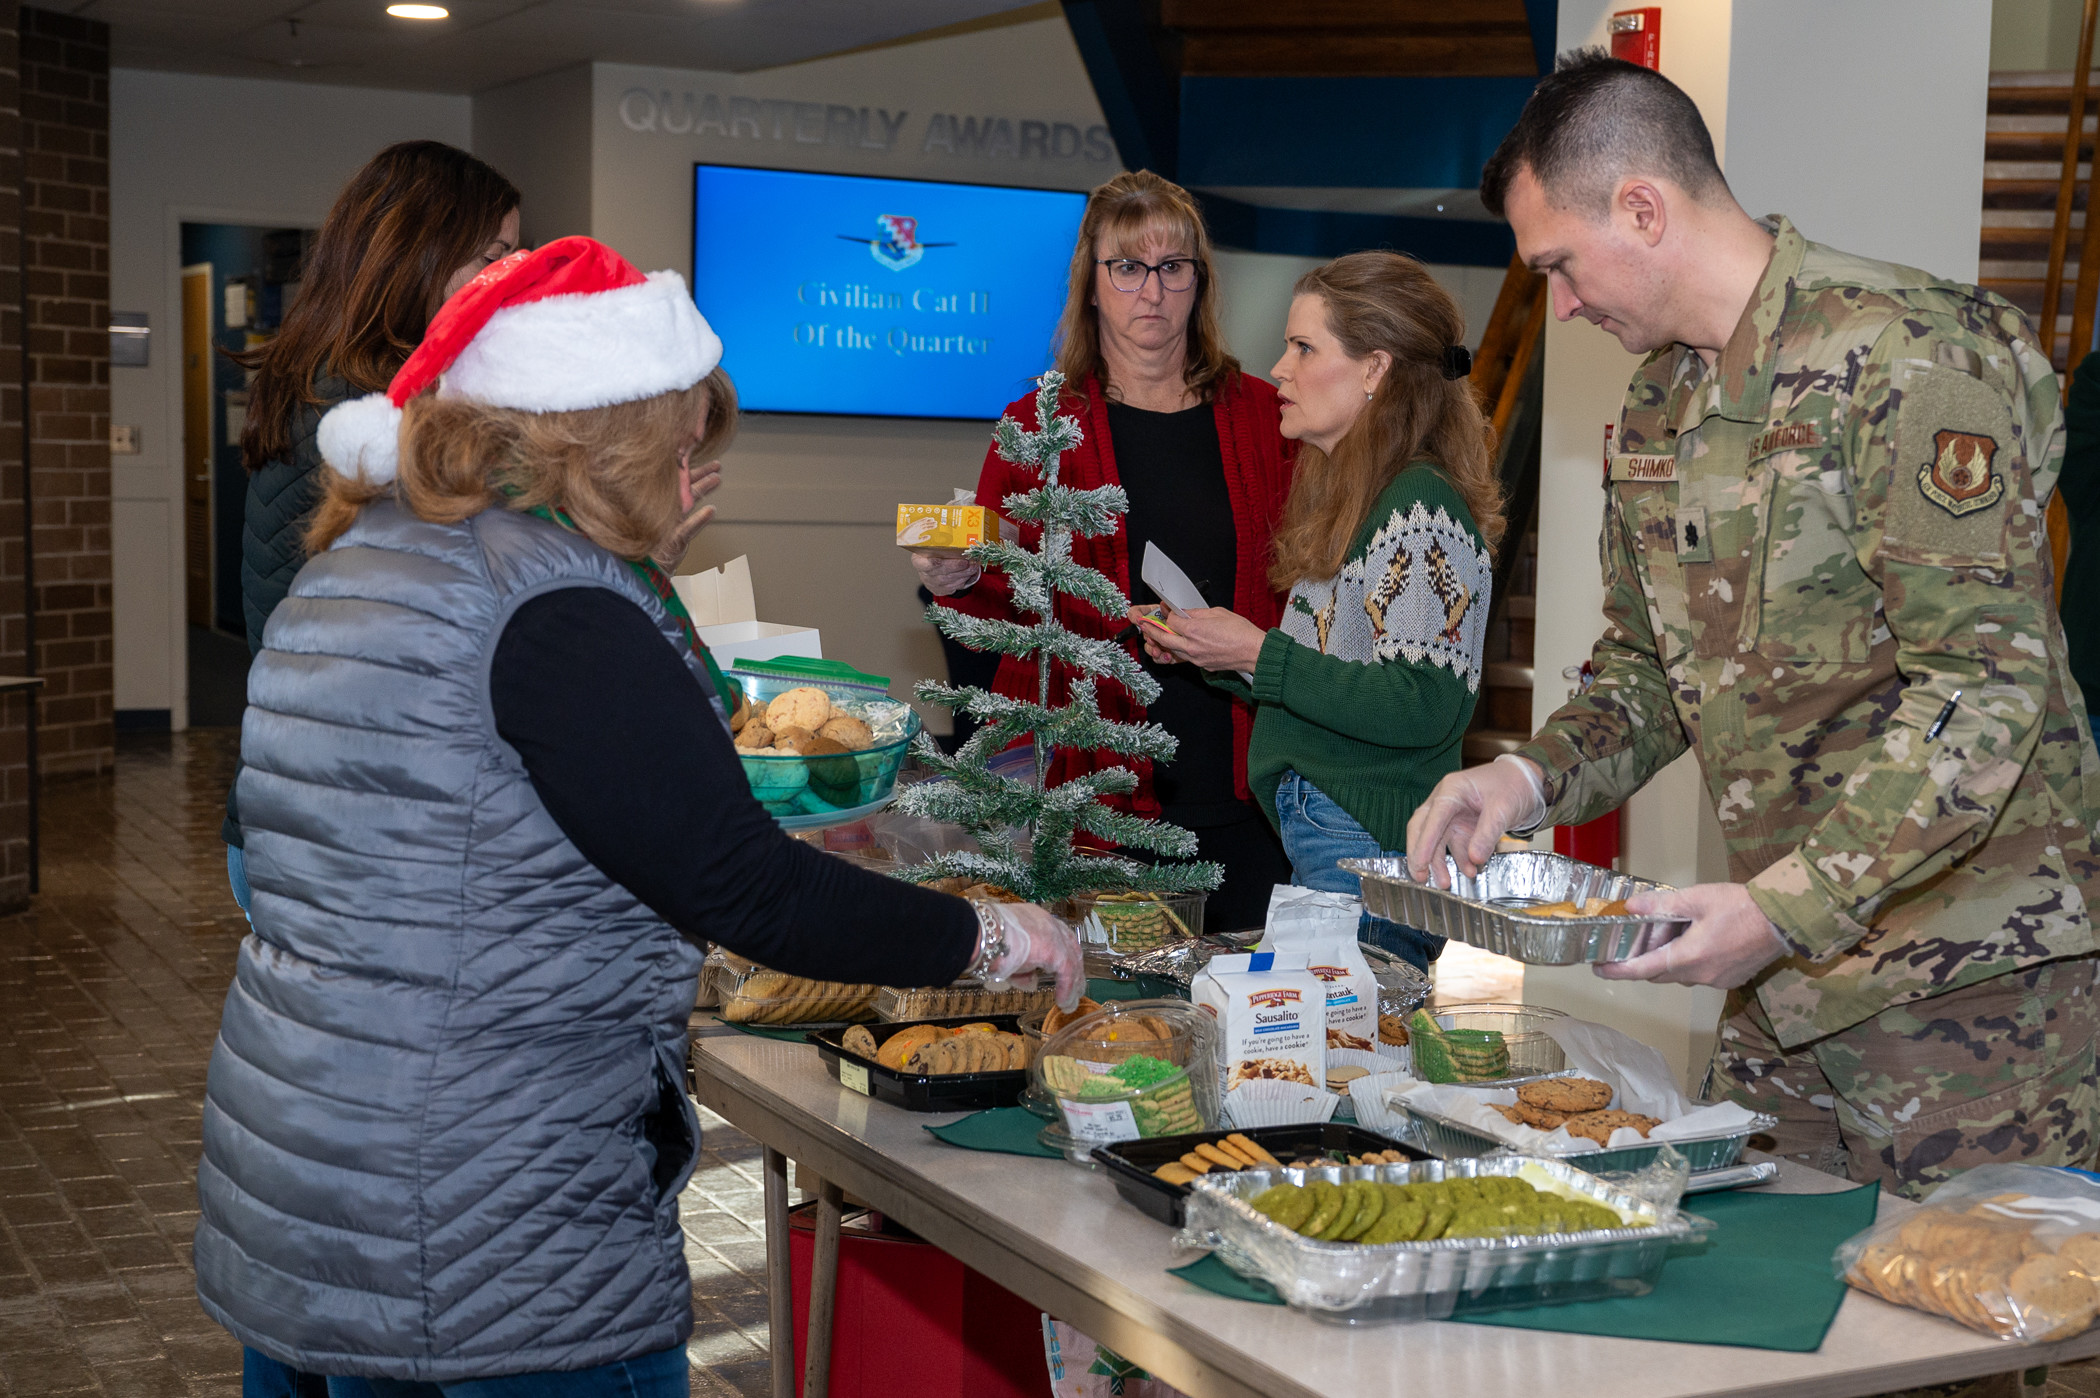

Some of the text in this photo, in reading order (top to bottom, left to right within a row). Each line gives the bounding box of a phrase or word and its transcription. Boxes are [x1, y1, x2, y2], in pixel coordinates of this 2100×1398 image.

[619, 87, 1113, 163] QUARTERLY AWARDS
[797, 281, 901, 309] Civilian
[913, 287, 957, 313] Cat
[793, 321, 994, 358] Of the Quarter
[1775, 423, 1816, 448] FORCE
[1628, 458, 1674, 478] SHIMKO
[967, 509, 980, 528] X3
[1282, 990, 1298, 998] FARM
[1326, 987, 1354, 999] ntauk
[1255, 1010, 1298, 1025] Sausalito
[1330, 1008, 1345, 1018] going
[1328, 1017, 1341, 1025] have
[1242, 1038, 1247, 1046] If
[1248, 1038, 1266, 1047] you're
[1267, 1036, 1283, 1045] going
[1244, 1046, 1265, 1055] cookie,
